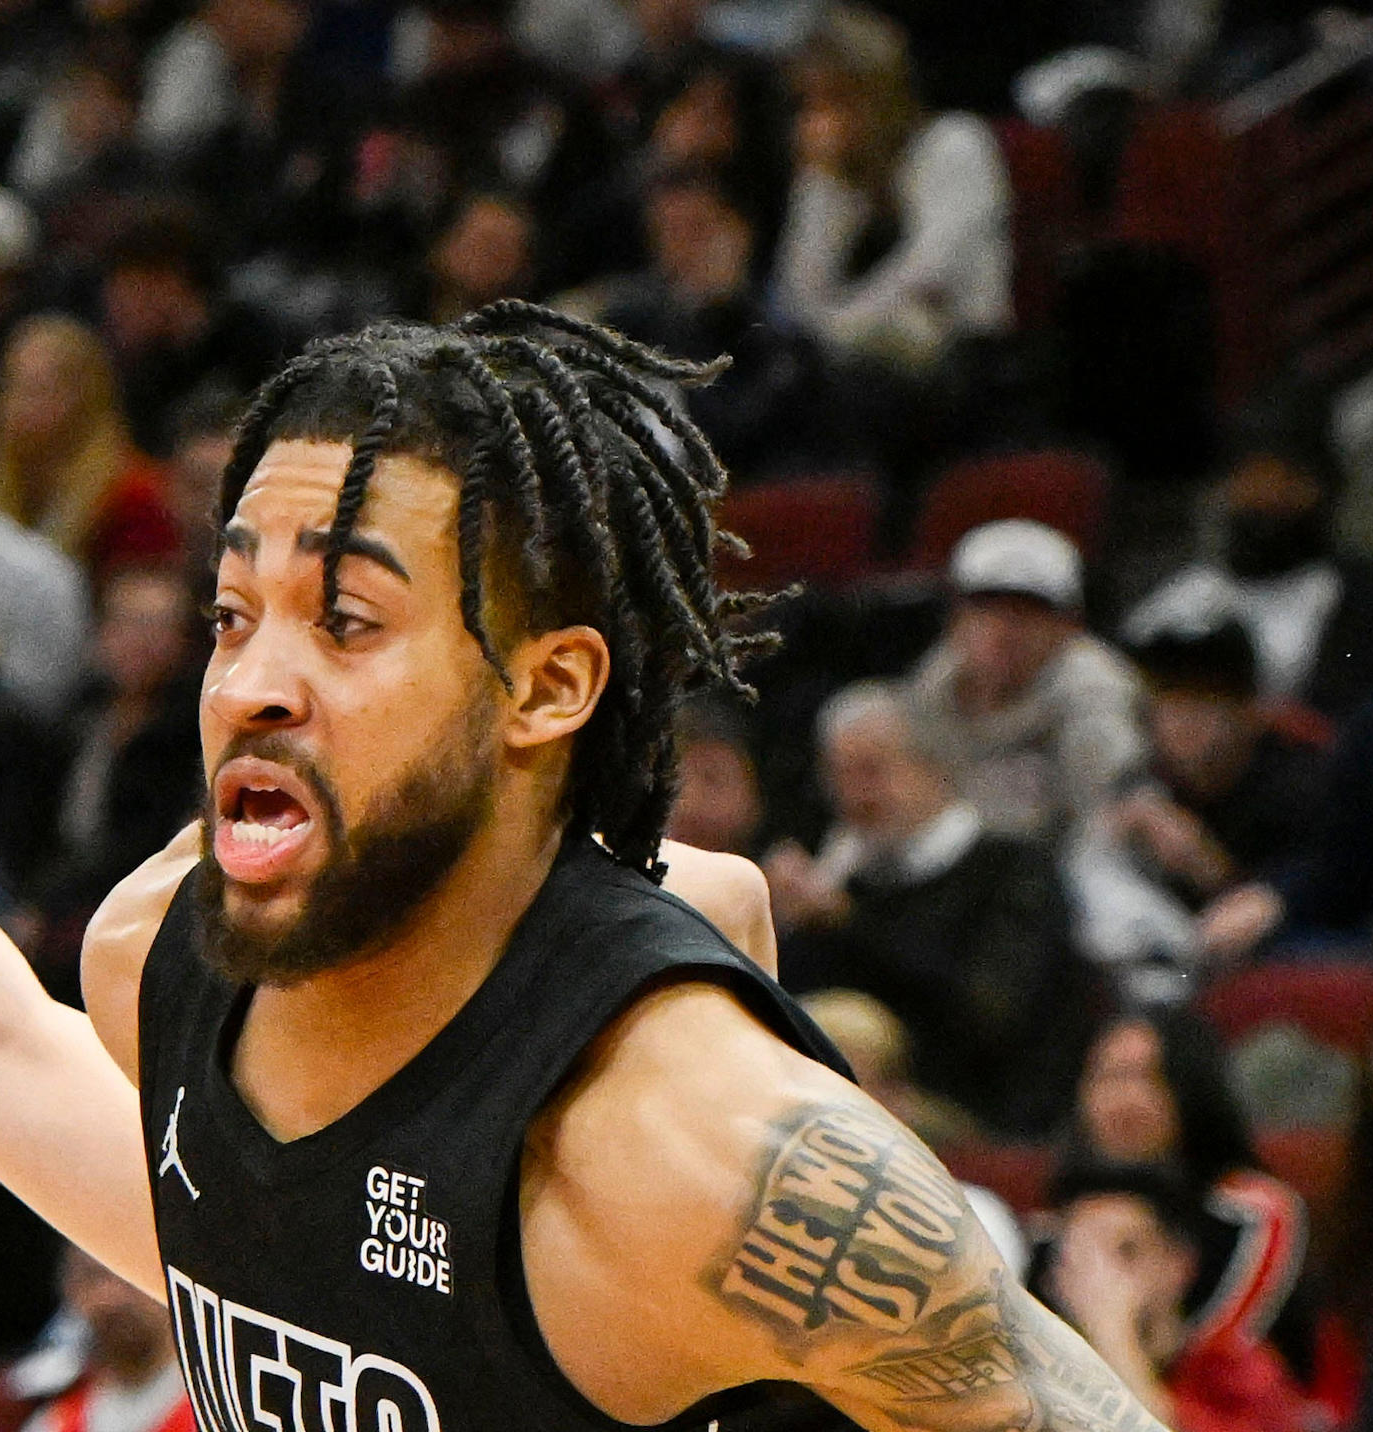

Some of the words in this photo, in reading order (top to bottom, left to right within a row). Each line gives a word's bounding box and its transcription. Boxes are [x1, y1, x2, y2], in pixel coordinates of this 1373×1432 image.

[367, 1166, 425, 1210] GET
[366, 1200, 447, 1257] YOUR
[360, 1237, 451, 1294] GUIDE
[720, 1200, 838, 1329] THE
[826, 1256, 930, 1334] IS
